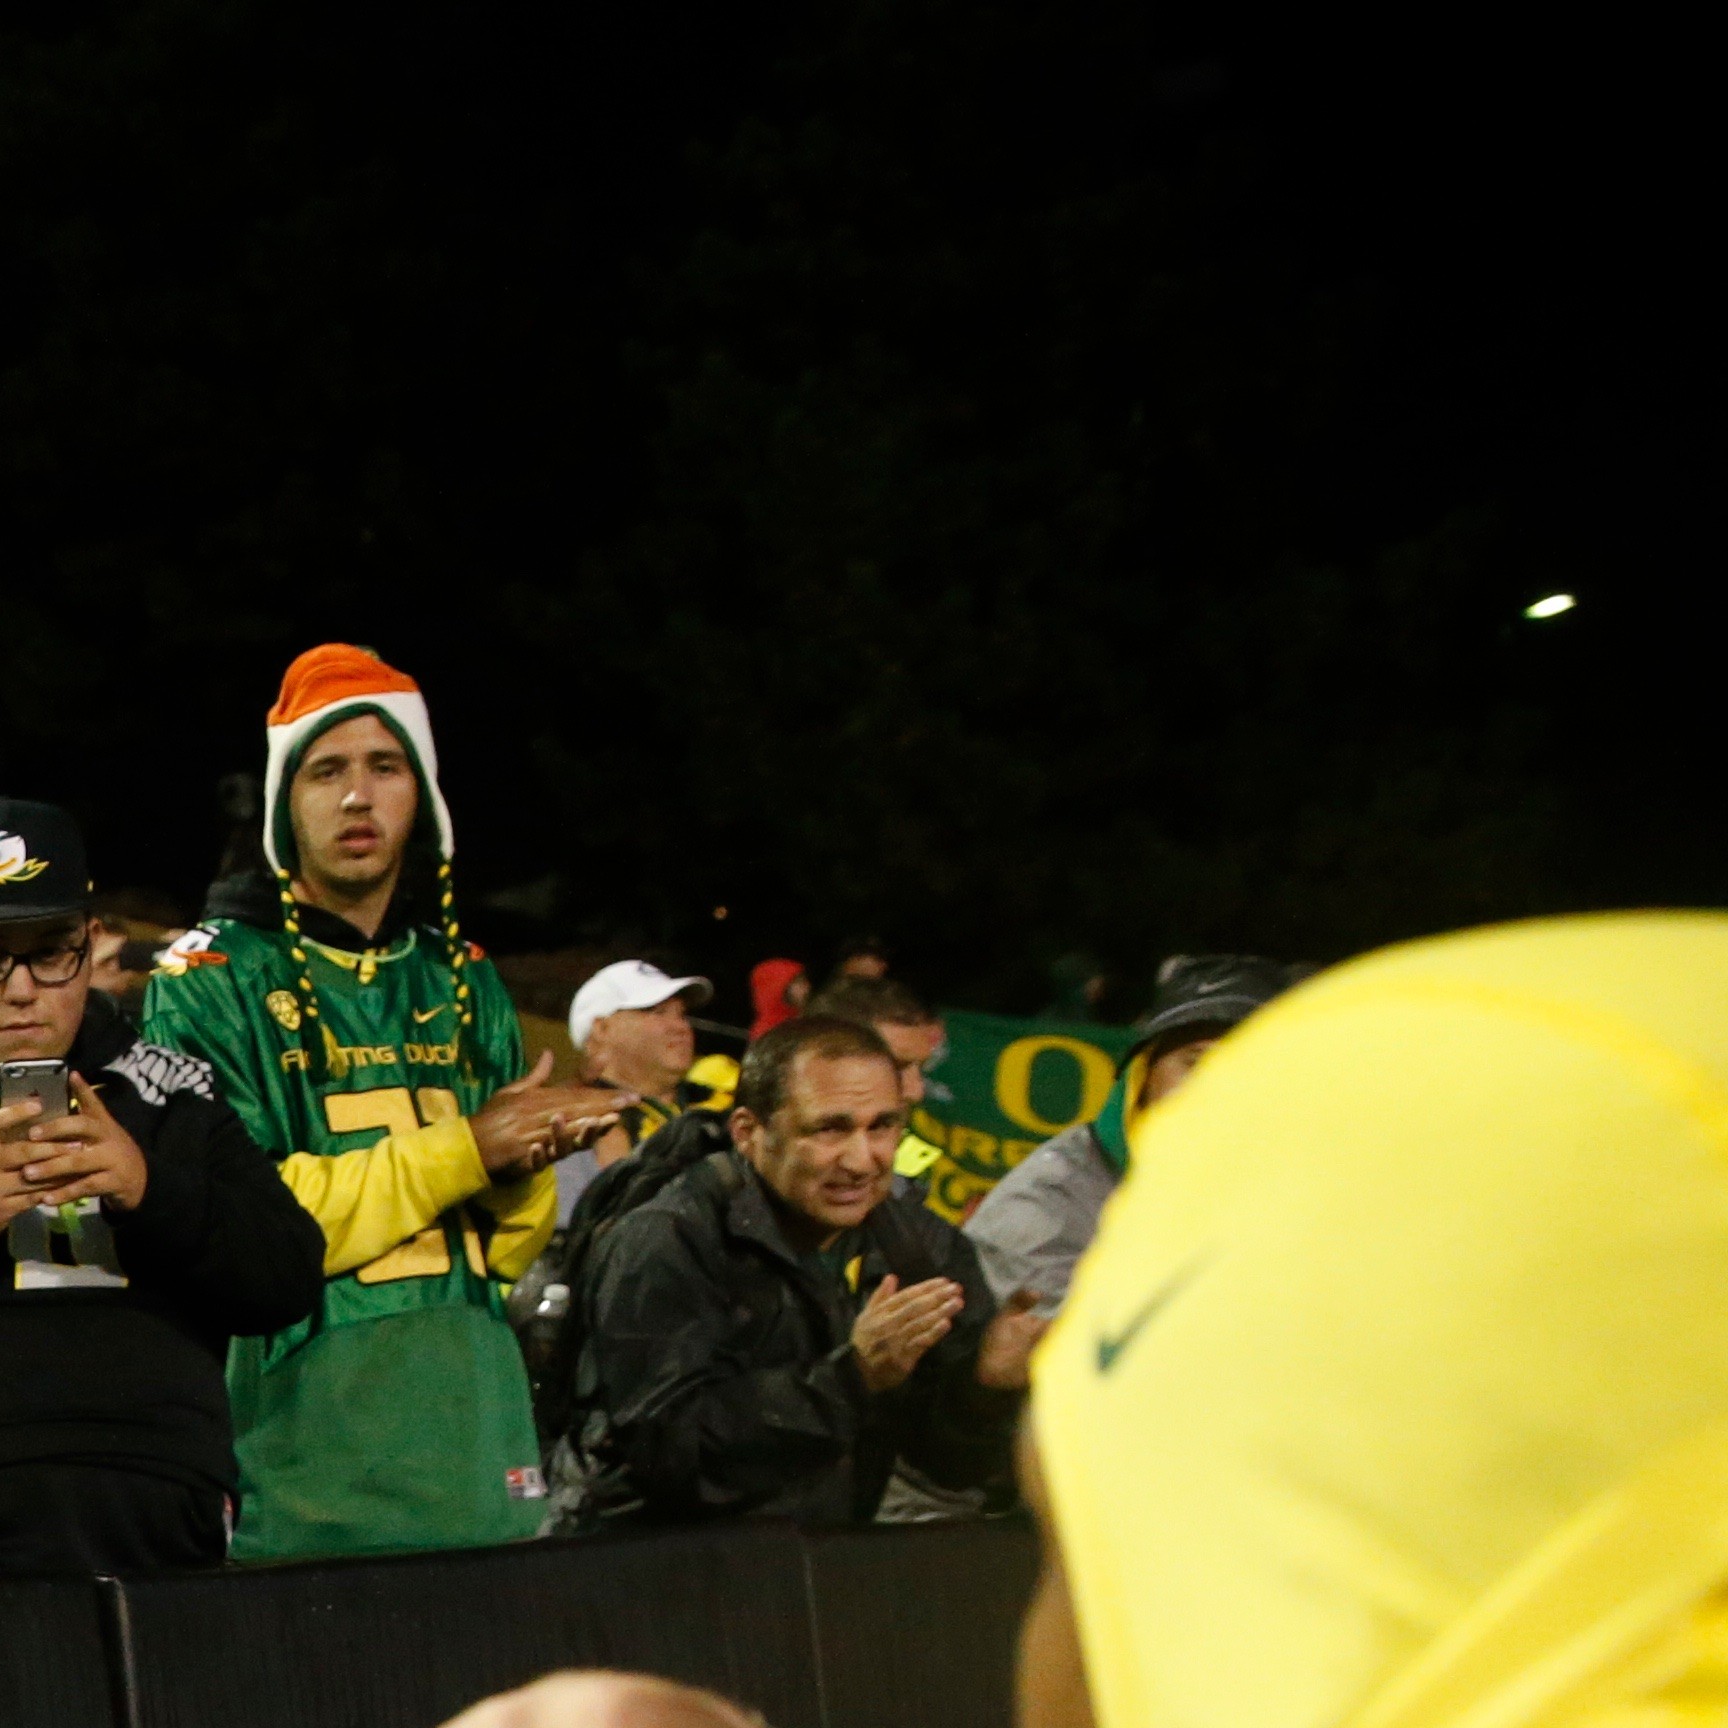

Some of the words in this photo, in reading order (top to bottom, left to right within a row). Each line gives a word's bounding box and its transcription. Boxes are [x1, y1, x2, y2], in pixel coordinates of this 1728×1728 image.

[280, 1045, 397, 1073] FITING
[403, 1041, 459, 1067] DUCK
[994, 1034, 1117, 1136] O
